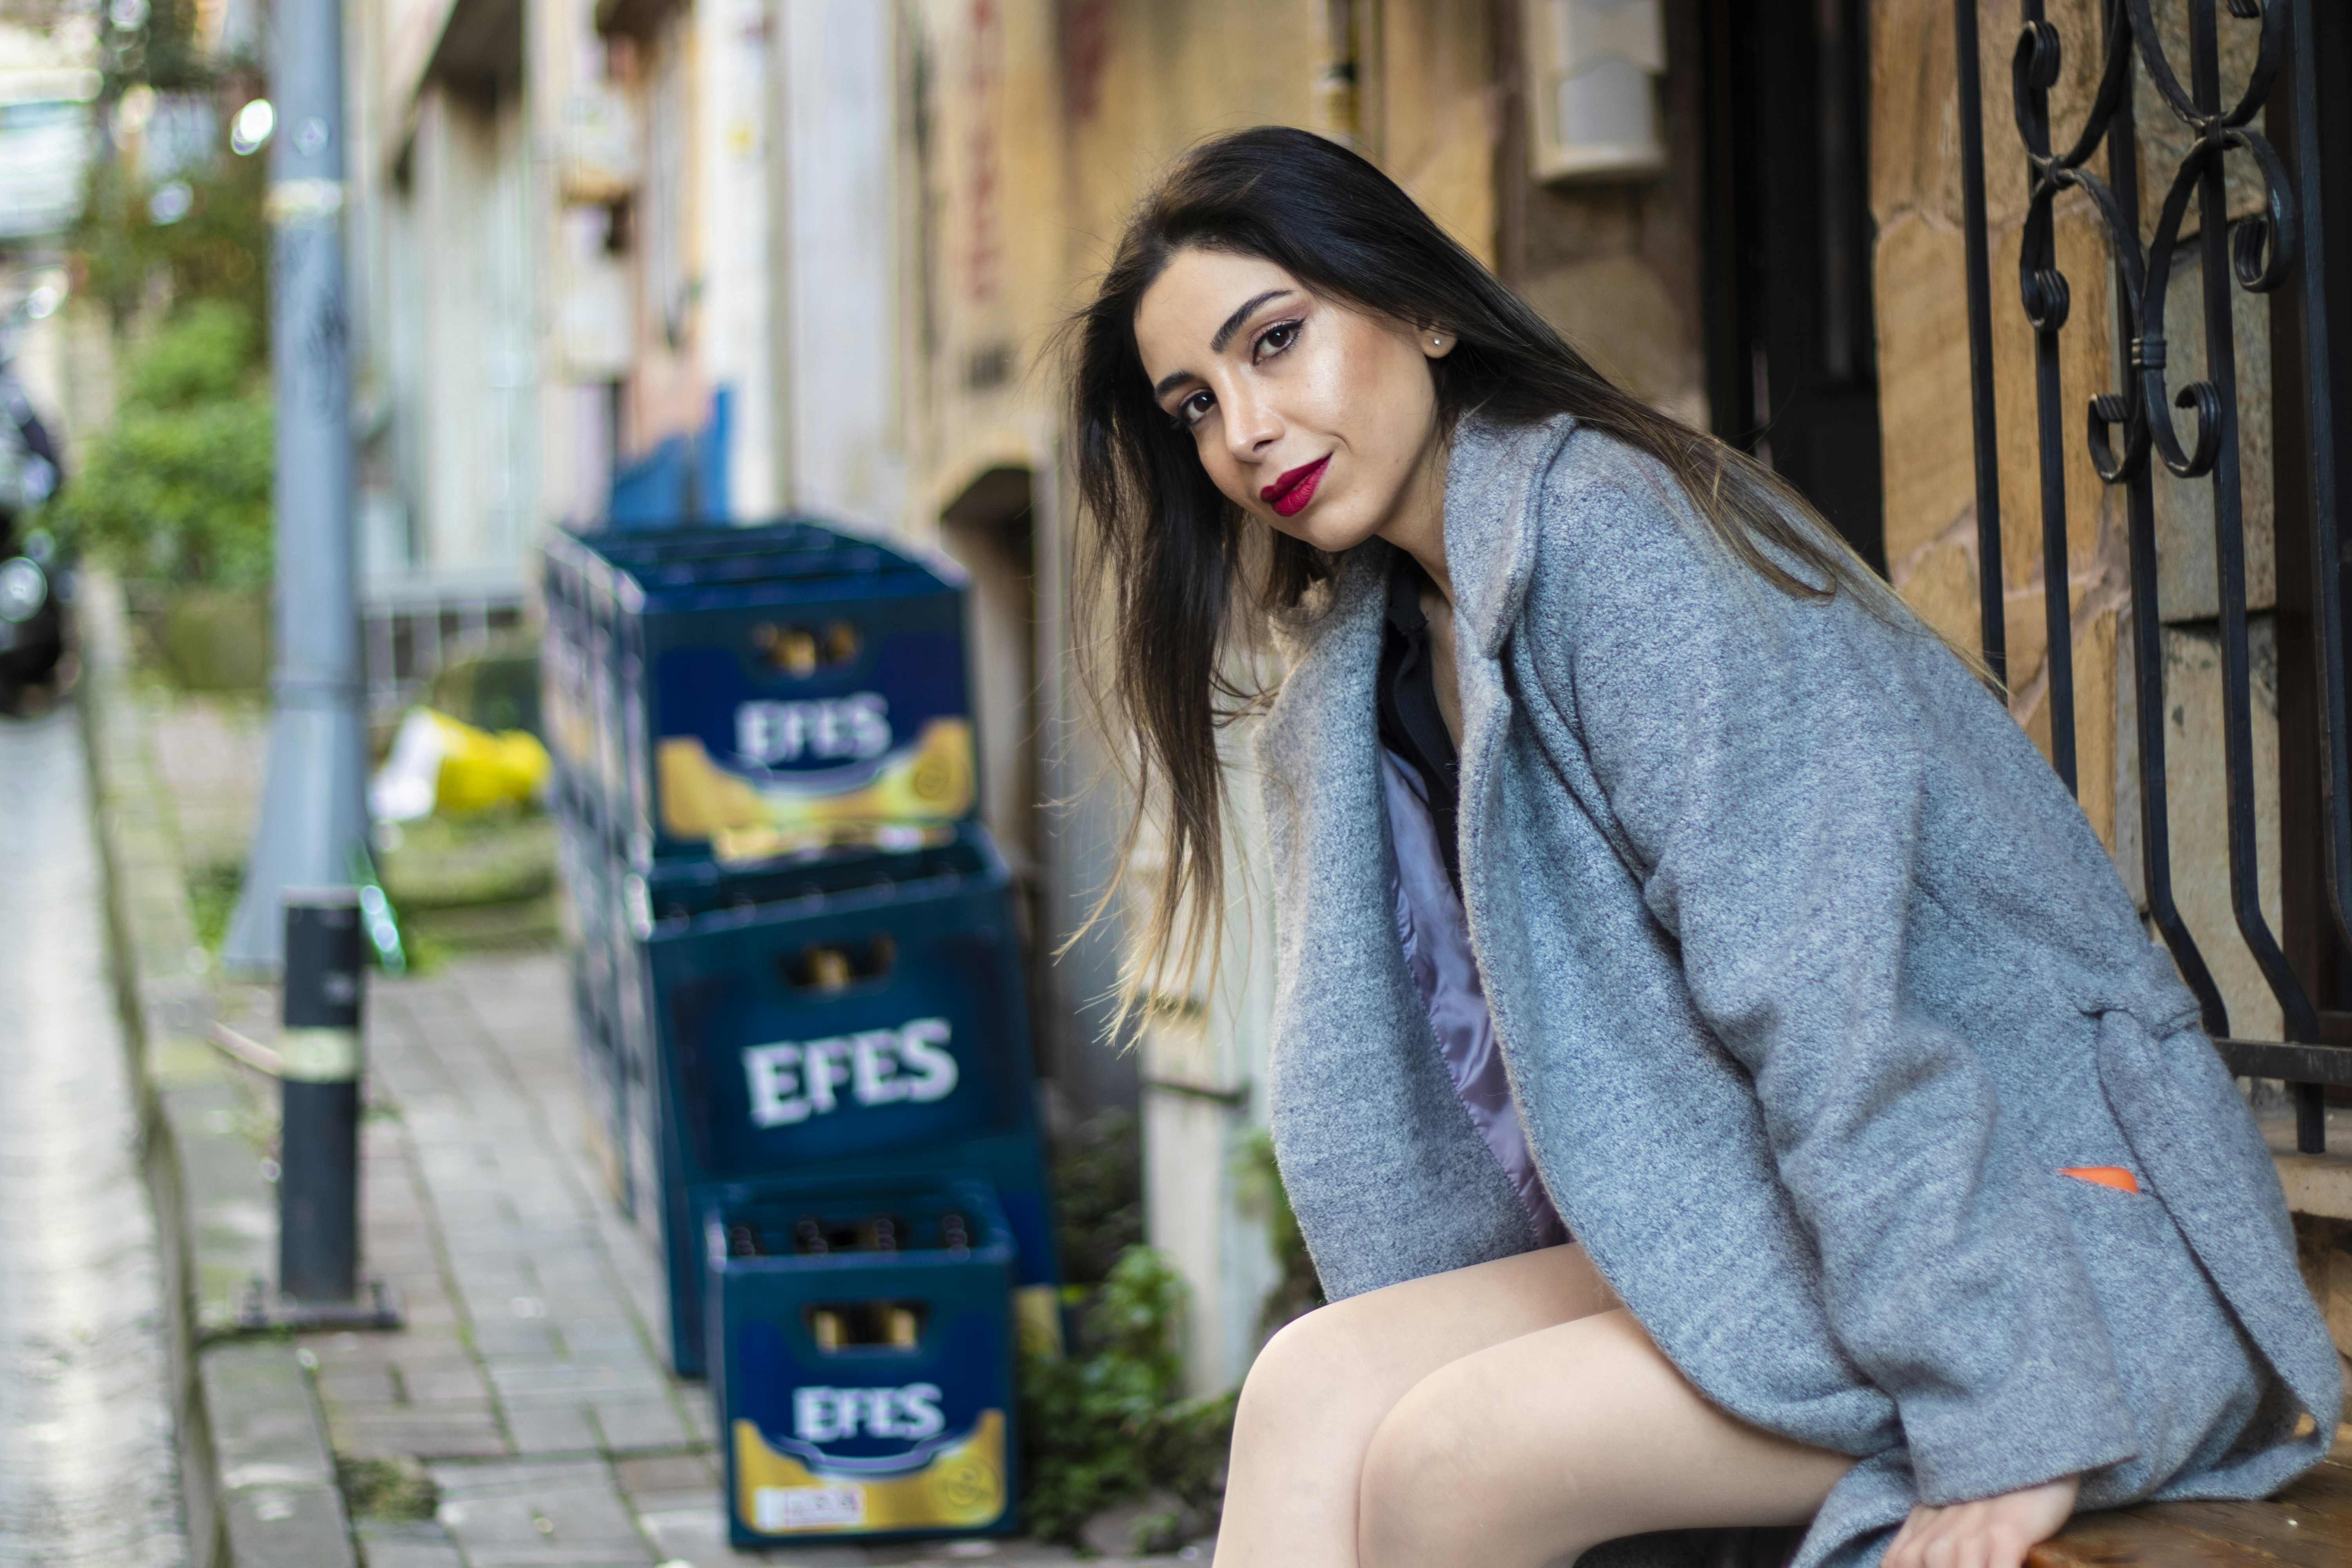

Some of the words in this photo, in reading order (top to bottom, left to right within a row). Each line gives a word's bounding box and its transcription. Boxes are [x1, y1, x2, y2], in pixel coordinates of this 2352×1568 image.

[736, 693, 891, 762] EFES
[742, 1018, 959, 1128] EFES
[792, 1382, 946, 1443] EFES
